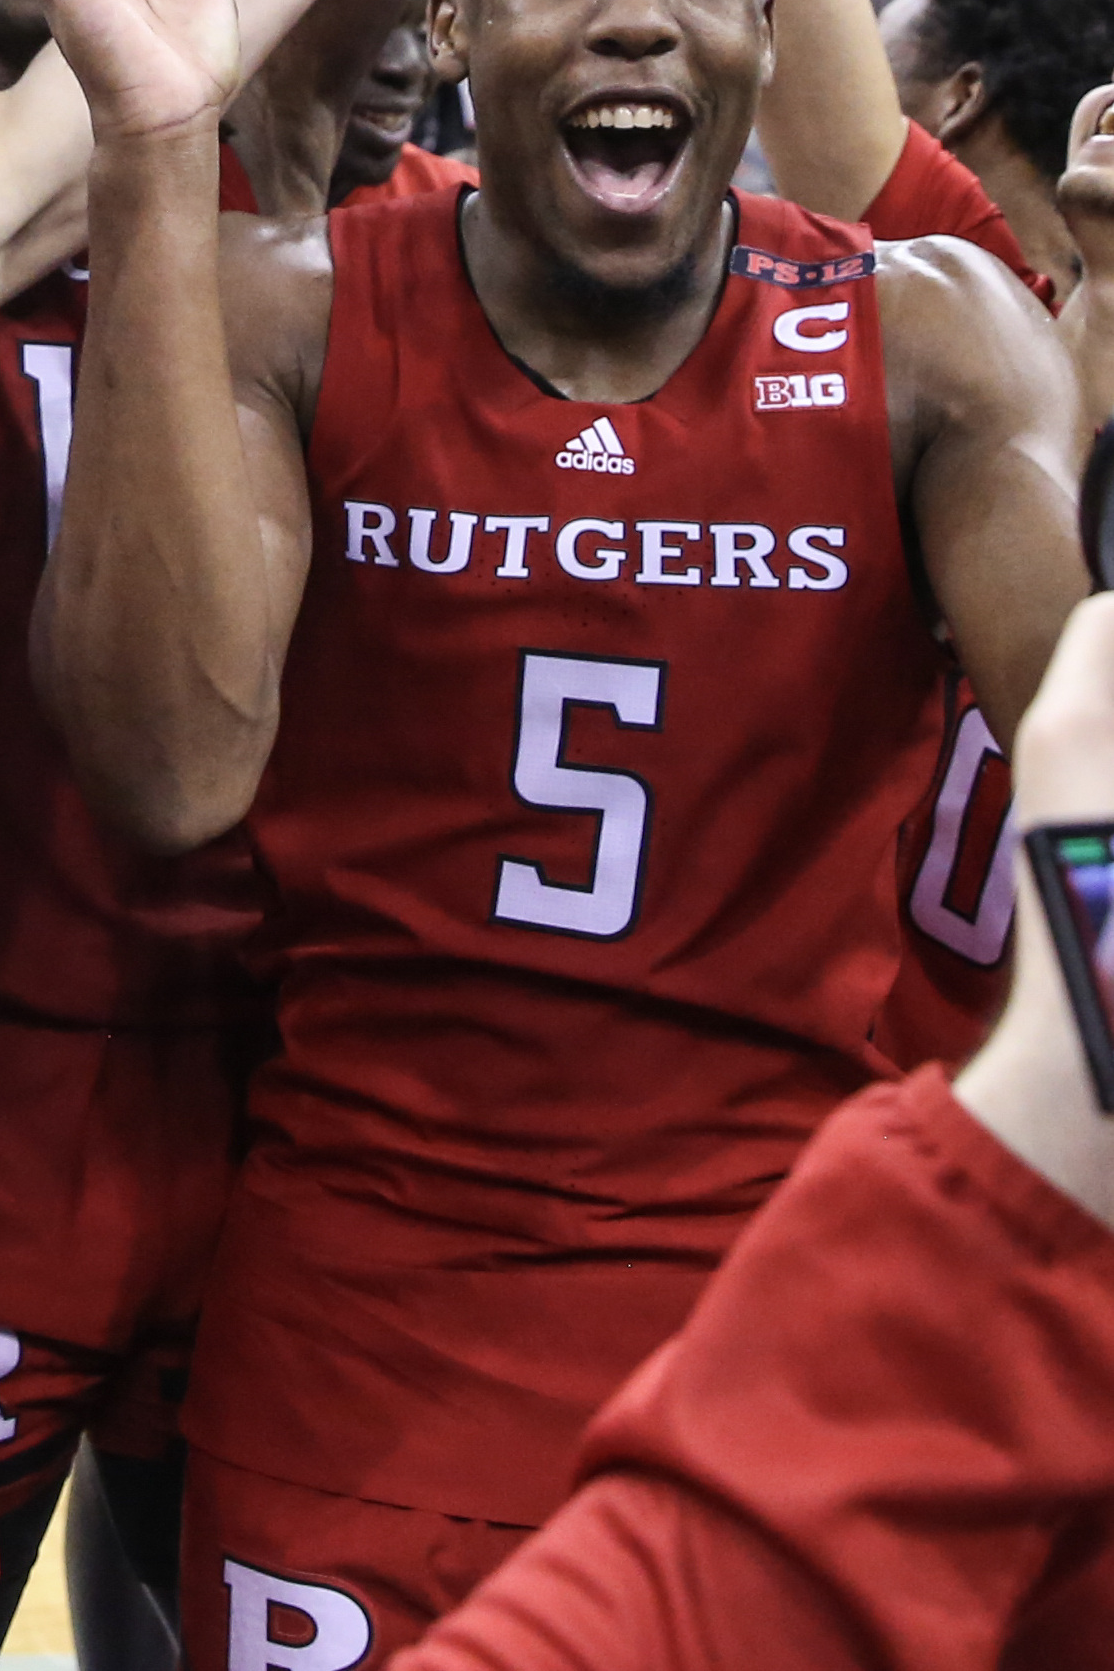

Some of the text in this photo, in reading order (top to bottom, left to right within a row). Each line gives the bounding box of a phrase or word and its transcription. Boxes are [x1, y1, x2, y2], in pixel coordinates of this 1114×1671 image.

[773, 301, 849, 353] C
[555, 448, 635, 476] adidas
[343, 499, 850, 592] RUTGERS
[490, 646, 669, 944] 5
